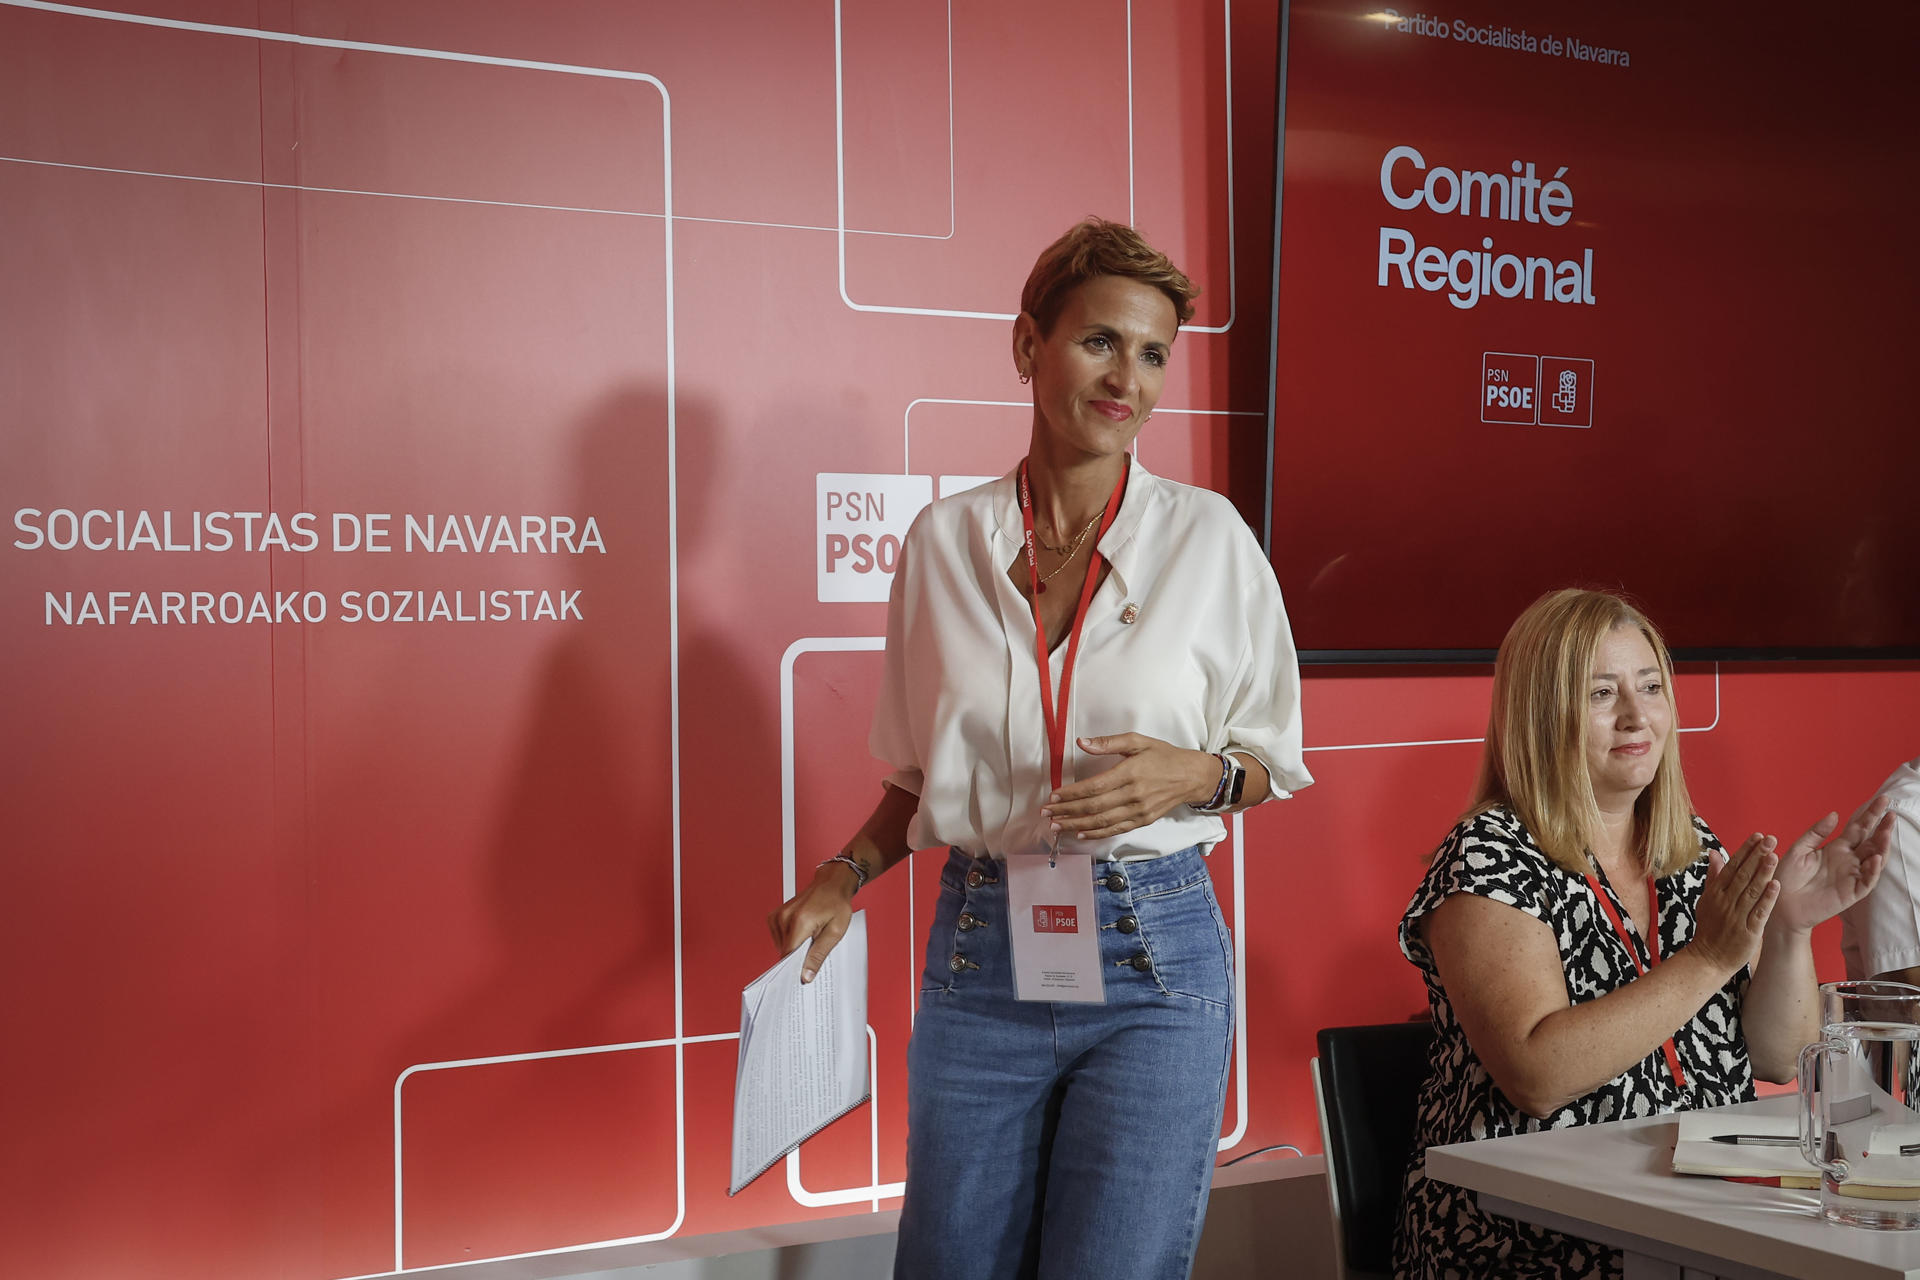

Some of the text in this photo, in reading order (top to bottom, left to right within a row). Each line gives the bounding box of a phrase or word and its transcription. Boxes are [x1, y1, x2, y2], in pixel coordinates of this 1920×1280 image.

[1384, 8, 1630, 67] Partido Socialista de Navarra
[1380, 145, 1573, 226] Comité
[1378, 227, 1596, 309] Regional
[1487, 368, 1509, 382] PSN
[1486, 384, 1533, 409] PSOE
[826, 491, 885, 522] PSN
[13, 508, 607, 554] SOCIALISTAS DE NAVARRA
[1026, 529, 1035, 567] PSOE
[826, 533, 901, 574] PSO
[45, 590, 584, 625] NAFARROAKO SOZIALISTAK
[1055, 917, 1076, 927] PSOE
